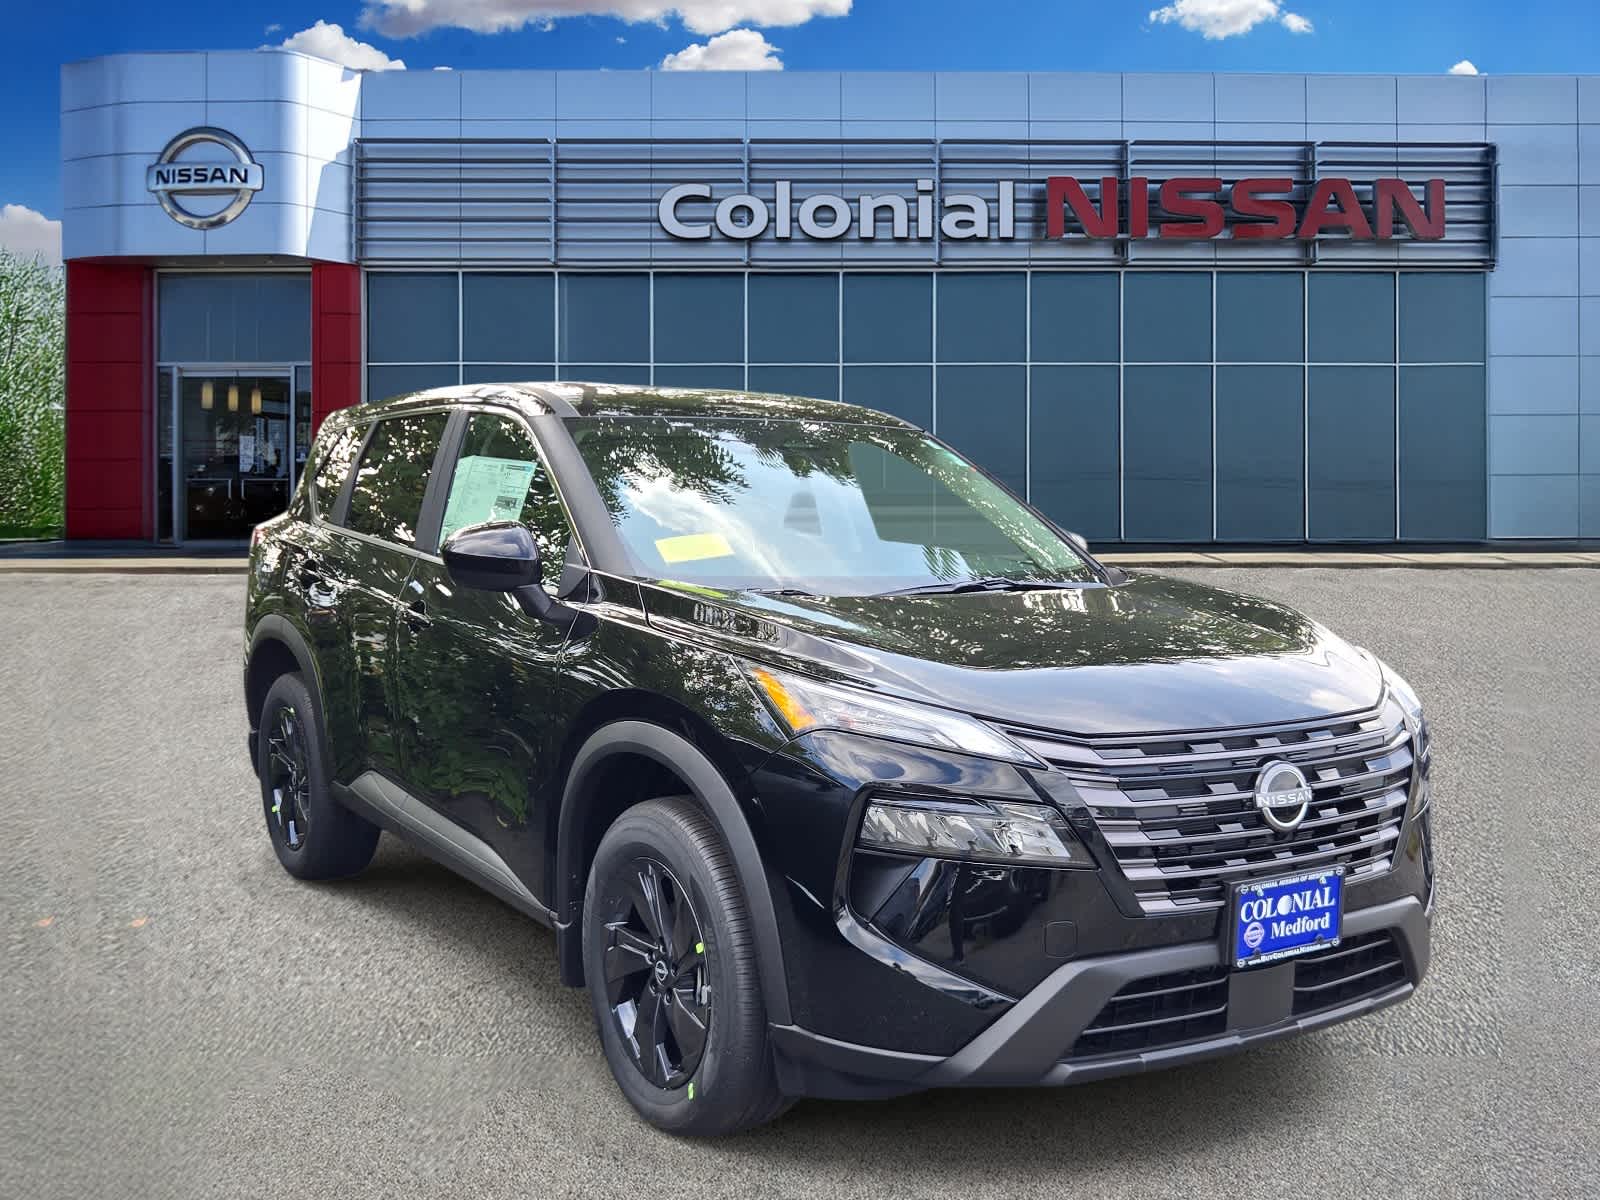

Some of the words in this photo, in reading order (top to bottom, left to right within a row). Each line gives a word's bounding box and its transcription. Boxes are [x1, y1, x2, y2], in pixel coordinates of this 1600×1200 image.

[156, 167, 248, 185] NISSAN
[658, 179, 1014, 240] Colonial
[1045, 176, 1446, 240] NISSAN
[1258, 790, 1312, 806] NISSAN
[1240, 886, 1335, 922] COLONIAL
[1270, 912, 1330, 939] Medford
